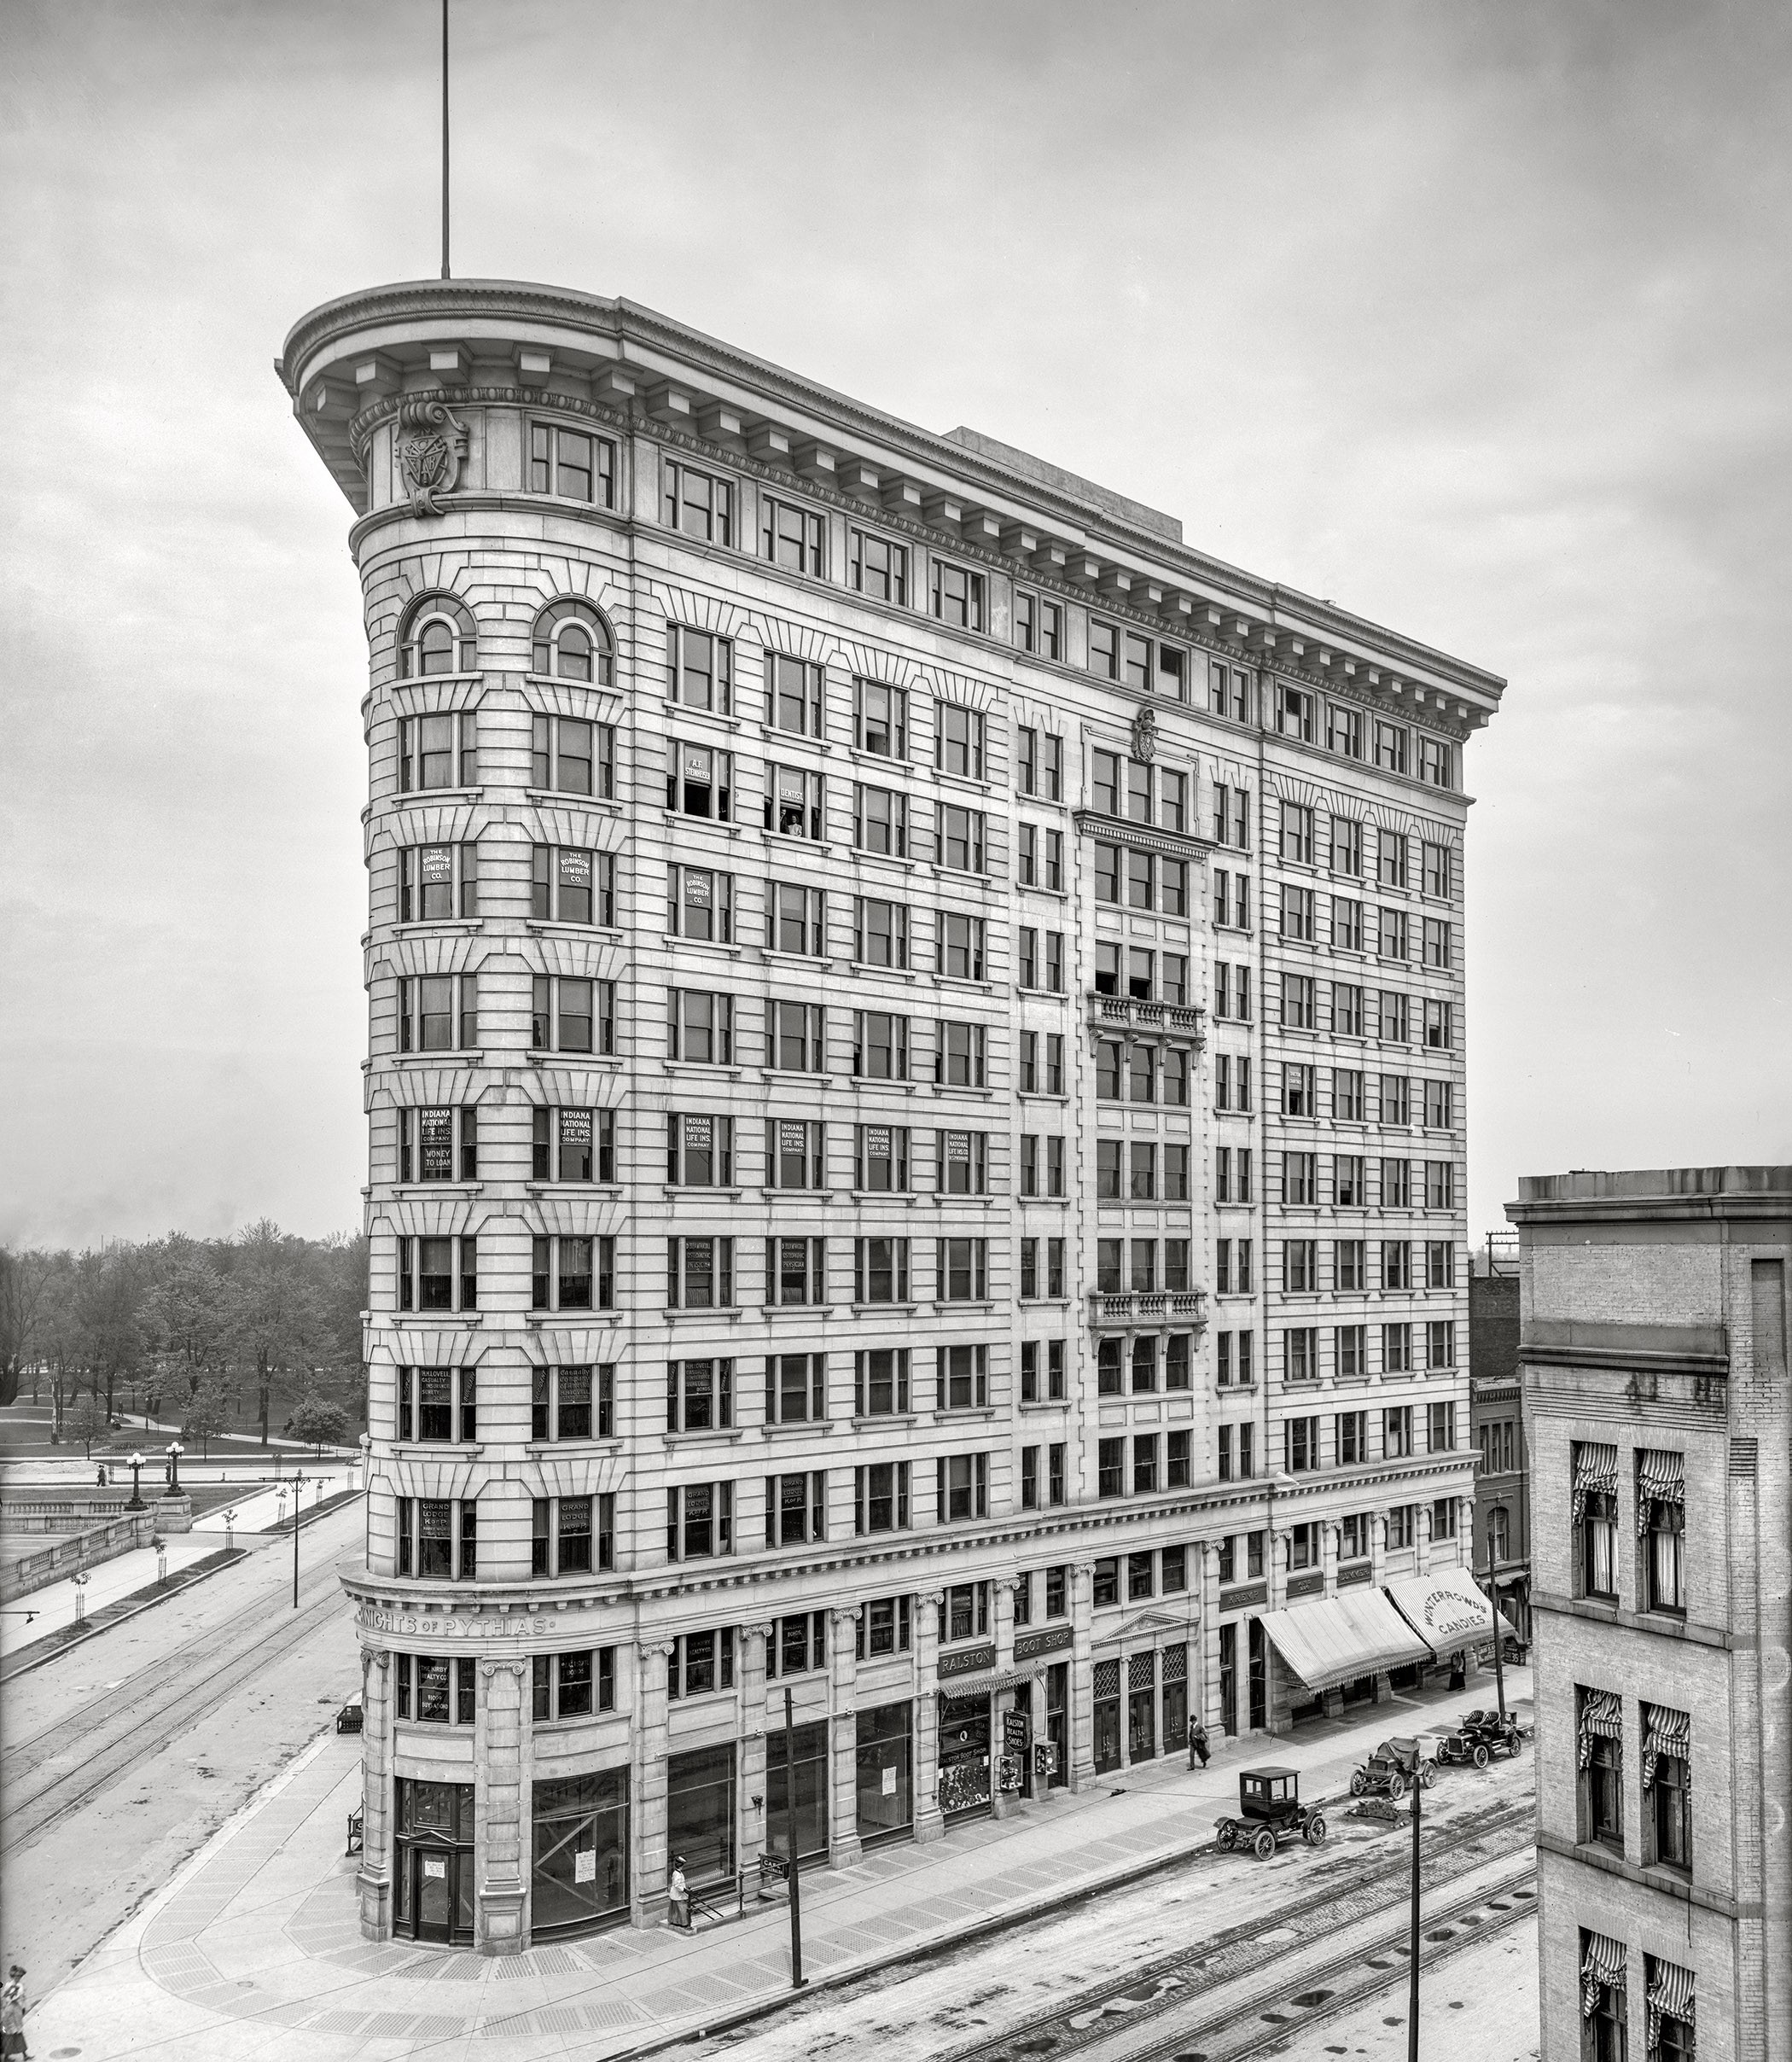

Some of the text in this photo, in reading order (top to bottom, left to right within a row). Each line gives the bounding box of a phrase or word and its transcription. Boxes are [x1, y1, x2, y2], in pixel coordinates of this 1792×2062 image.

[423, 854, 451, 865] ROBINSON
[560, 858, 590, 868] ROBINSON
[423, 863, 451, 871] LUMBER
[561, 866, 590, 876] LUMBER
[686, 879, 710, 891] ROBINSON
[687, 888, 709, 897] LUMBER
[561, 1111, 591, 1120] INDIANA
[561, 1120, 591, 1128] NATIONAL
[686, 1117, 711, 1126] INDIANA
[686, 1126, 711, 1134] NATIONAL
[781, 1123, 804, 1132] INDIANA
[868, 1136, 890, 1145] NATIONAL
[561, 1512, 589, 1521] LODGE
[1423, 1591, 1487, 1627] WINTERROWD'S
[359, 1606, 546, 1637] KNIGHTS OF PYTHIAS
[1439, 1615, 1486, 1634] CANDIES
[942, 1632, 1069, 1673] RALSTON BOOT SHOP
[1006, 1716, 1024, 1728] RALSTON
[1007, 1727, 1024, 1737] HEALTH
[960, 1750, 972, 1759] BOOT
